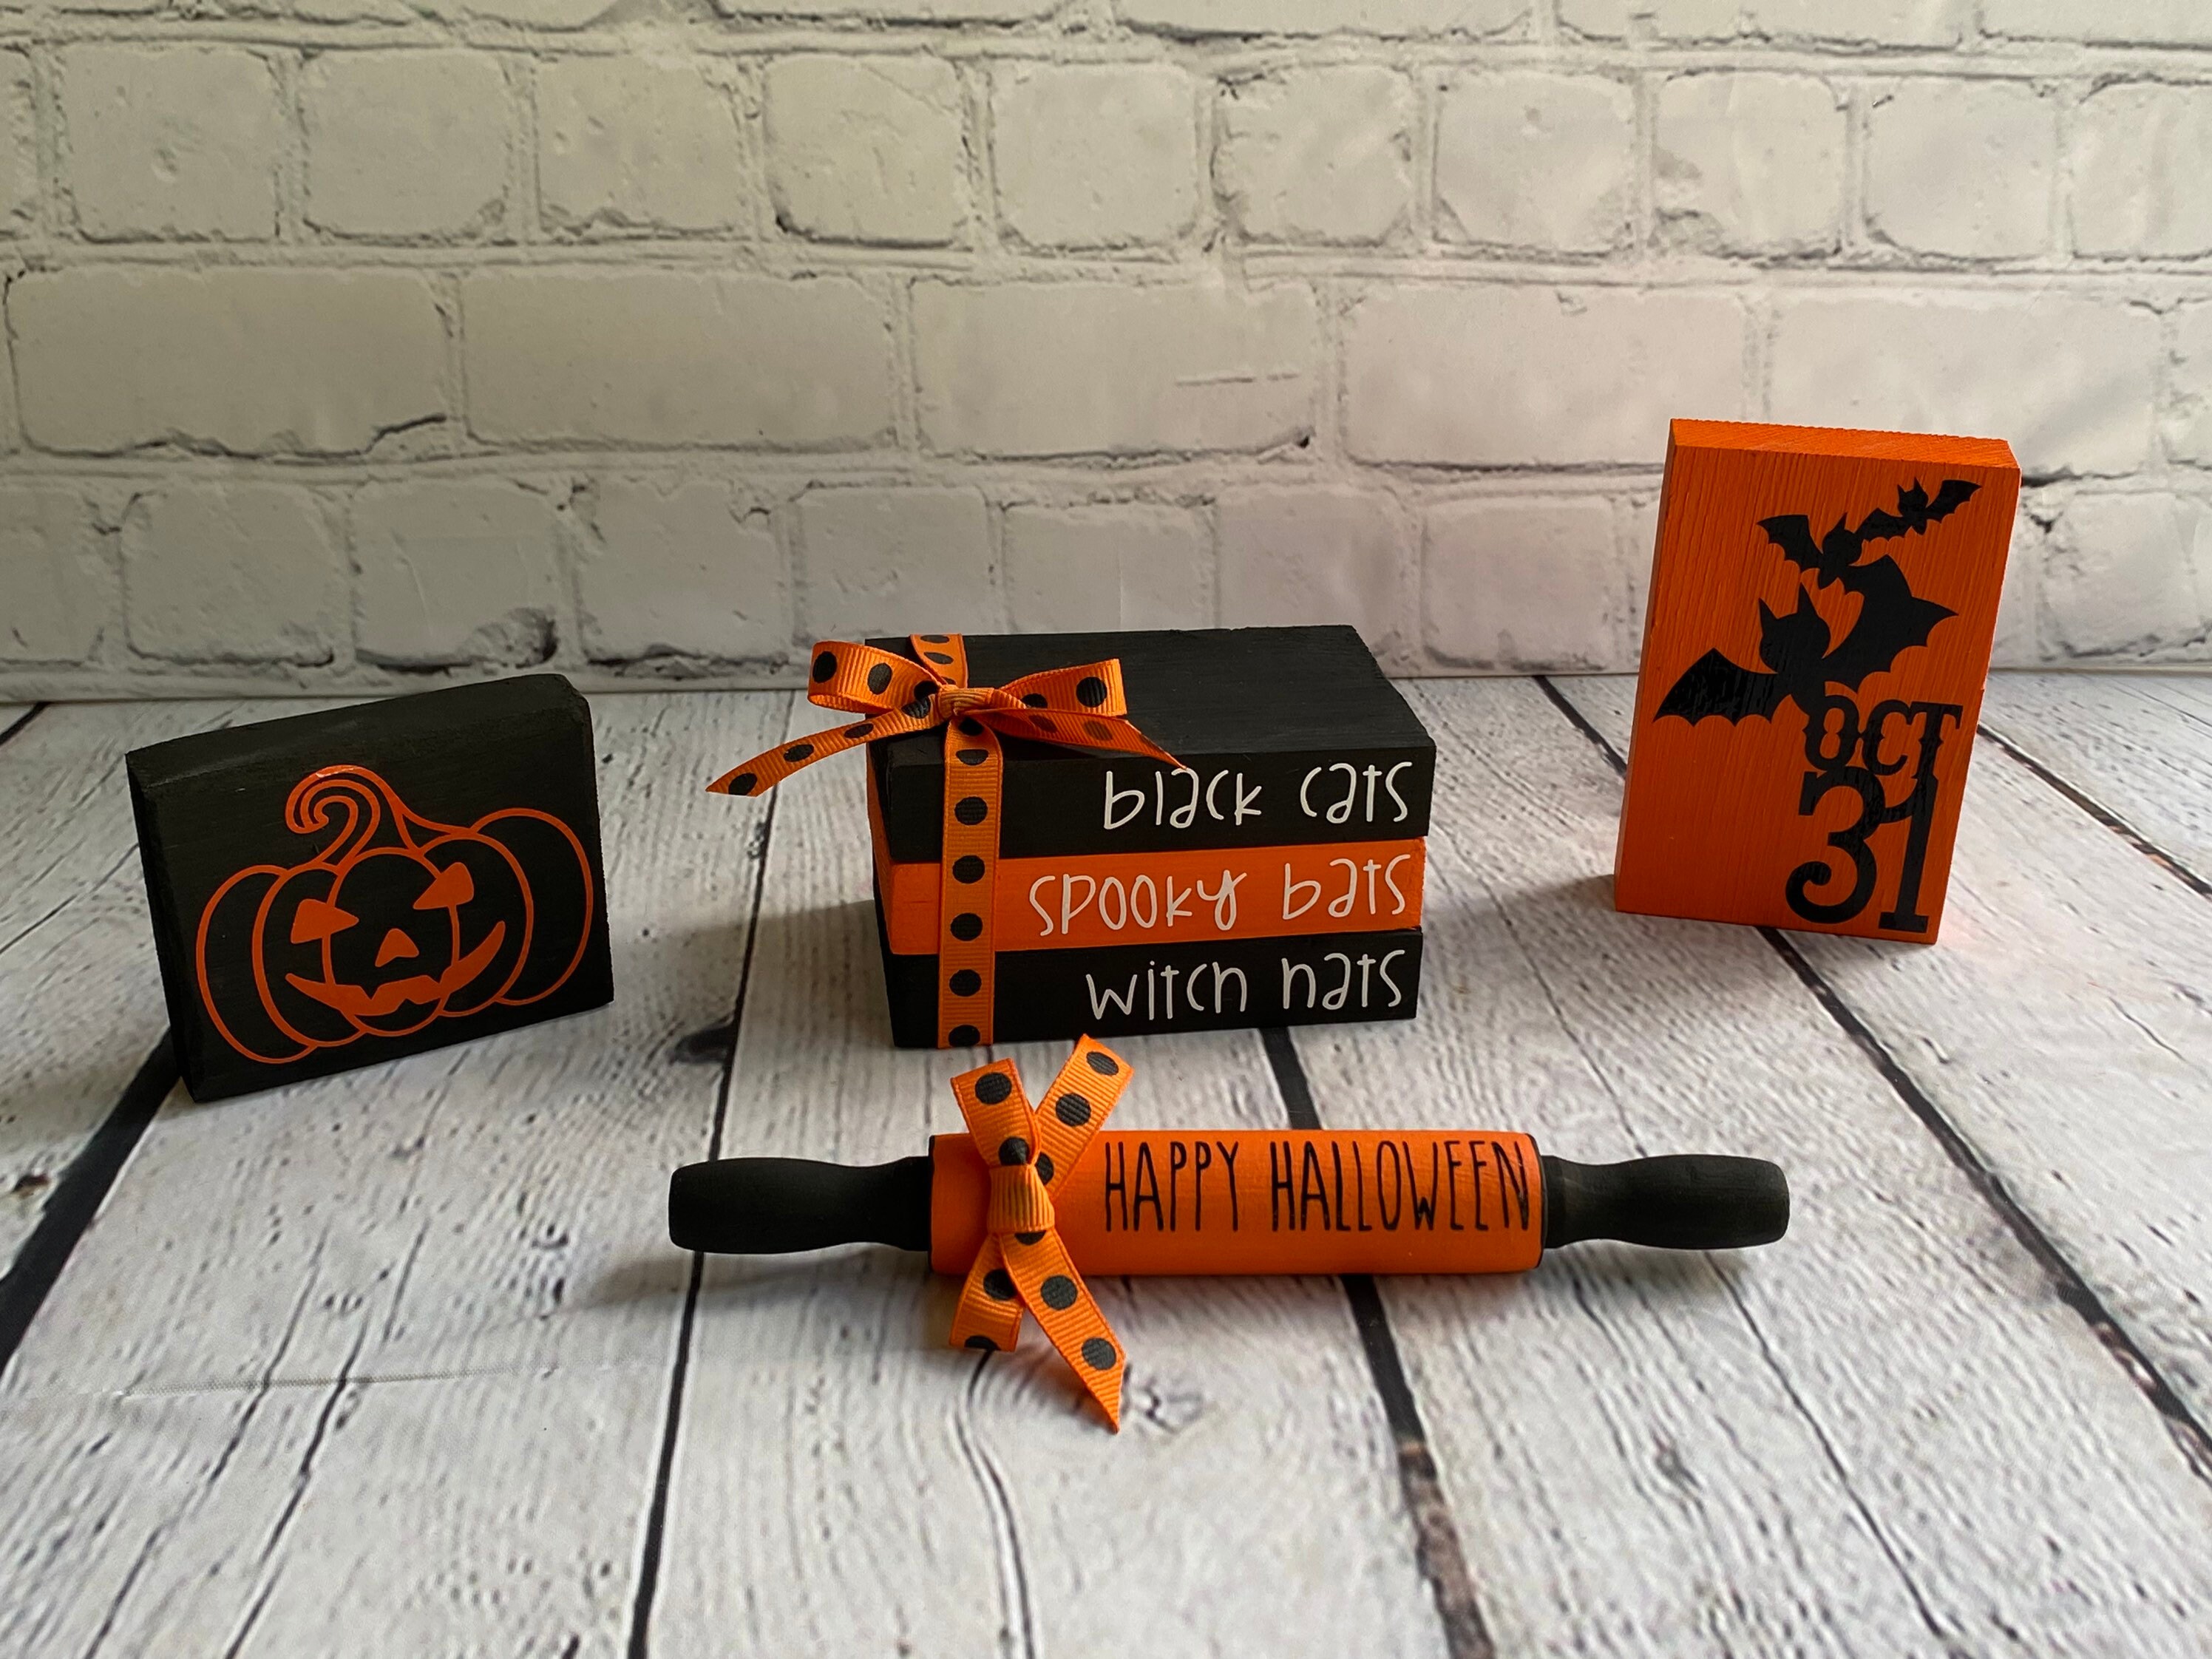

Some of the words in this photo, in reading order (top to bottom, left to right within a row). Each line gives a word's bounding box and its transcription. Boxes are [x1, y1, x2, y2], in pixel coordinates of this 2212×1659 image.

[1802, 694, 1964, 780] OCT
[1104, 769, 1262, 830] black
[1300, 761, 1413, 823] cats
[1785, 766, 1938, 933] 31
[1029, 869, 1247, 936] spooky
[1282, 854, 1411, 920] bats
[1105, 1141, 1239, 1232] HAPPY
[1271, 1139, 1530, 1232] HALLOWEEN
